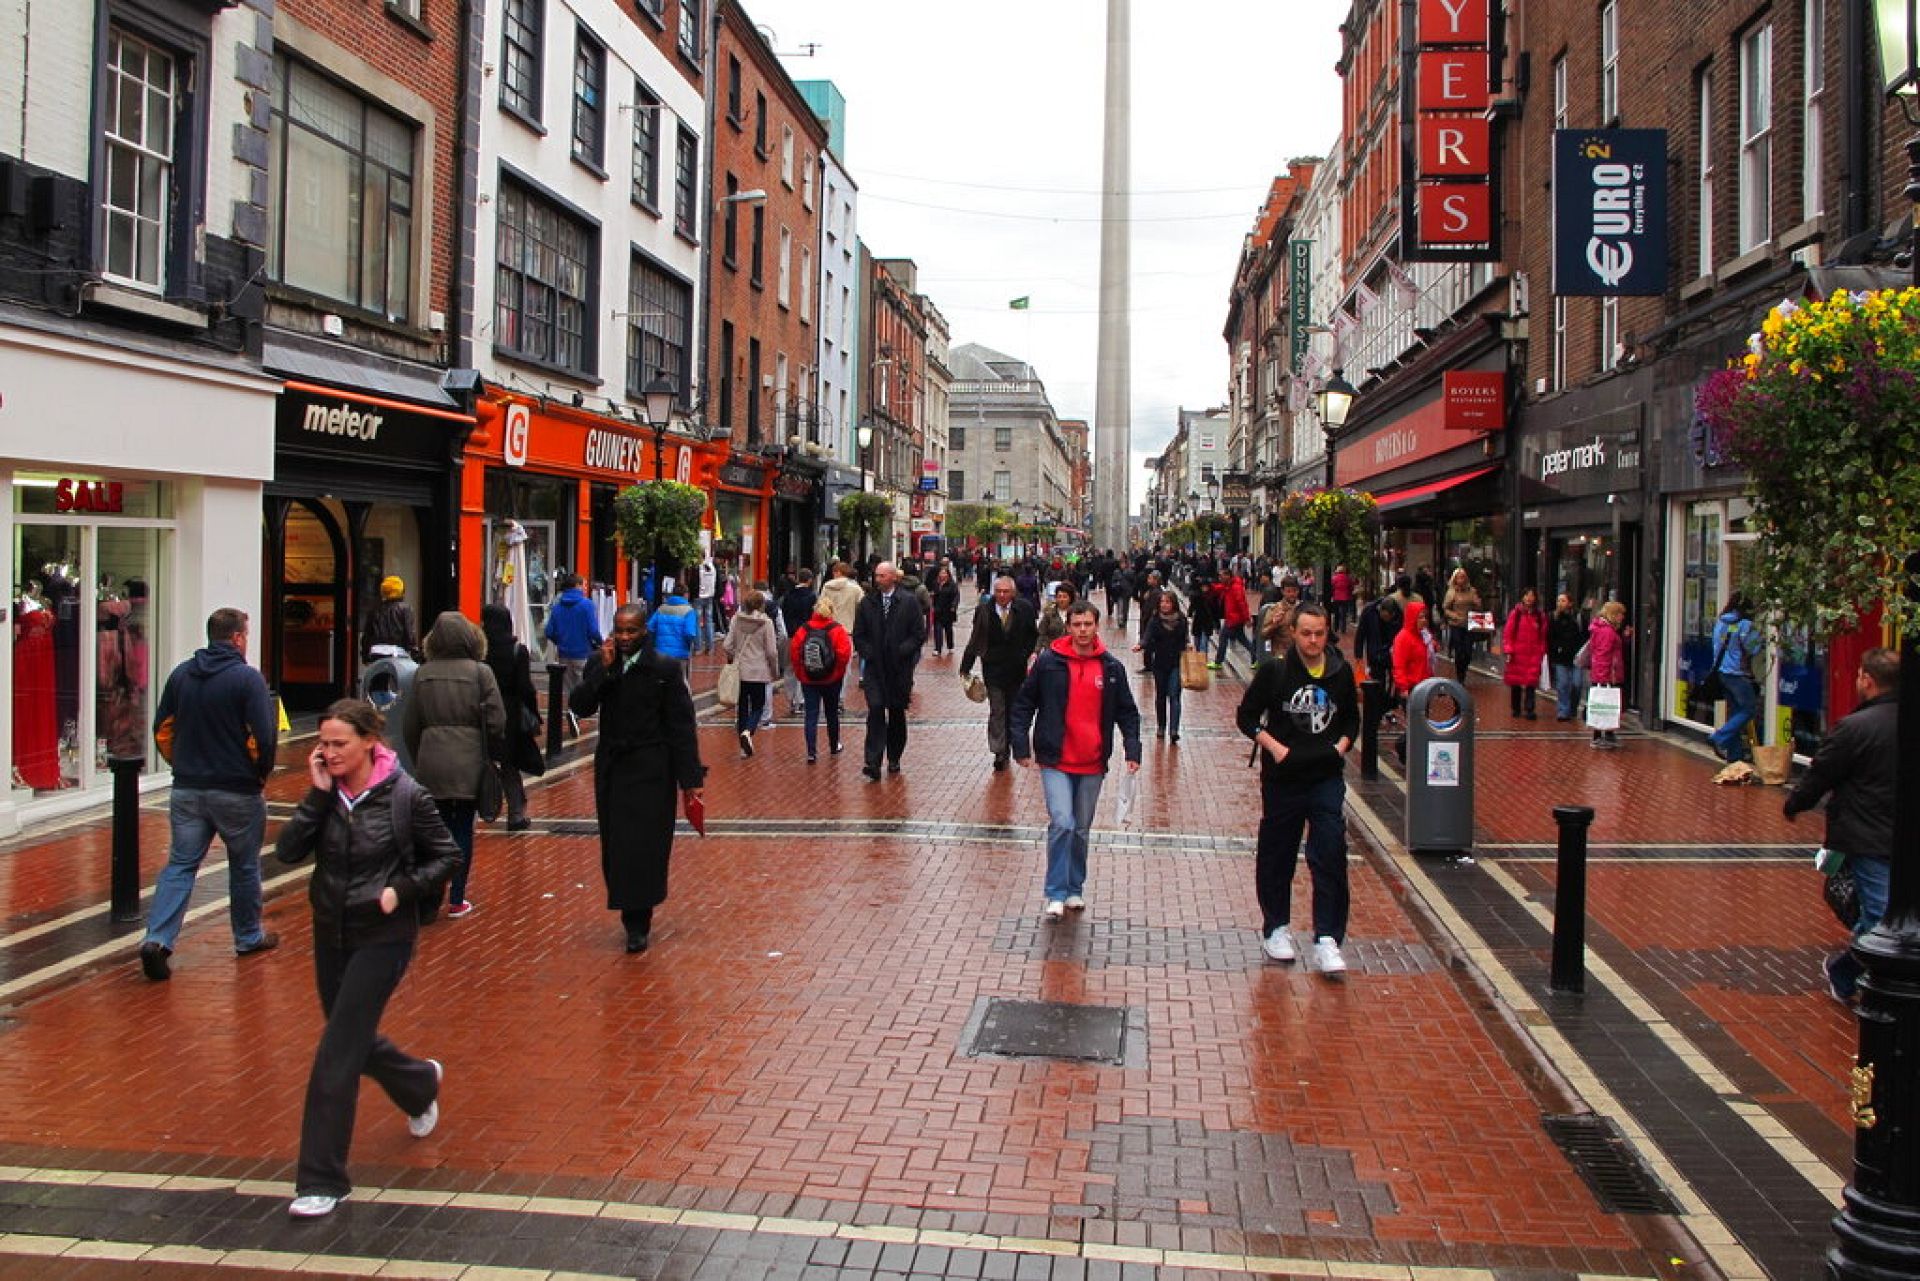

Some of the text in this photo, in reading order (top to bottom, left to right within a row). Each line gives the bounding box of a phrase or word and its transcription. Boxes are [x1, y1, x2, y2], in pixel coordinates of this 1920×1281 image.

[1296, 243, 1308, 320] DUNNES
[1450, 386, 1497, 396] BOYERS
[303, 403, 384, 441] meteor
[510, 411, 526, 459] G
[586, 428, 644, 474] GUINEYS
[1542, 449, 1570, 483] peter
[1572, 434, 1605, 470] mark
[56, 477, 123, 513] SALE
